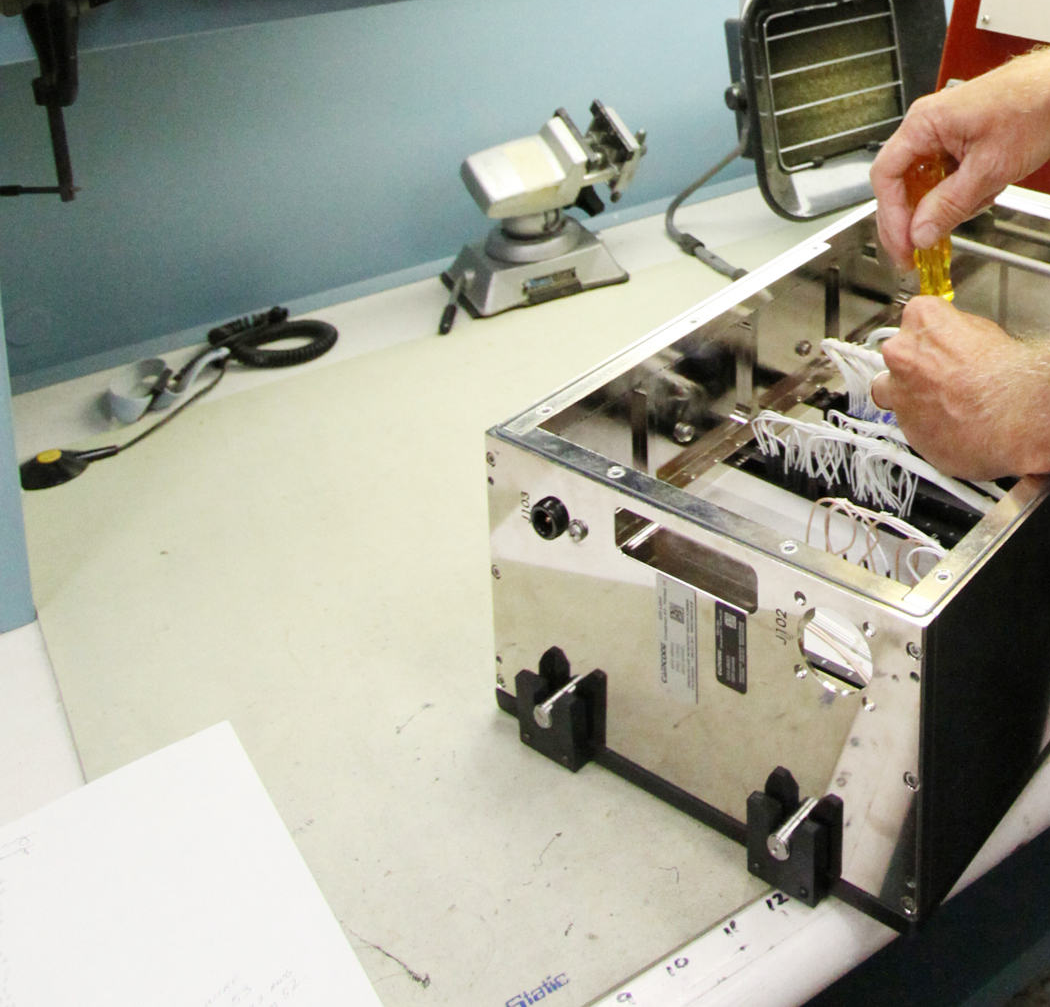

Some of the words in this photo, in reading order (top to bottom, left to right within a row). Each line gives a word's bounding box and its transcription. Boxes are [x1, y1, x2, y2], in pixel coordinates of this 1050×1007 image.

[520, 491, 532, 524] J103
[775, 608, 787, 645] J102
[666, 957, 689, 977] 10
[765, 892, 790, 912] 12
[505, 972, 570, 1007] Static
